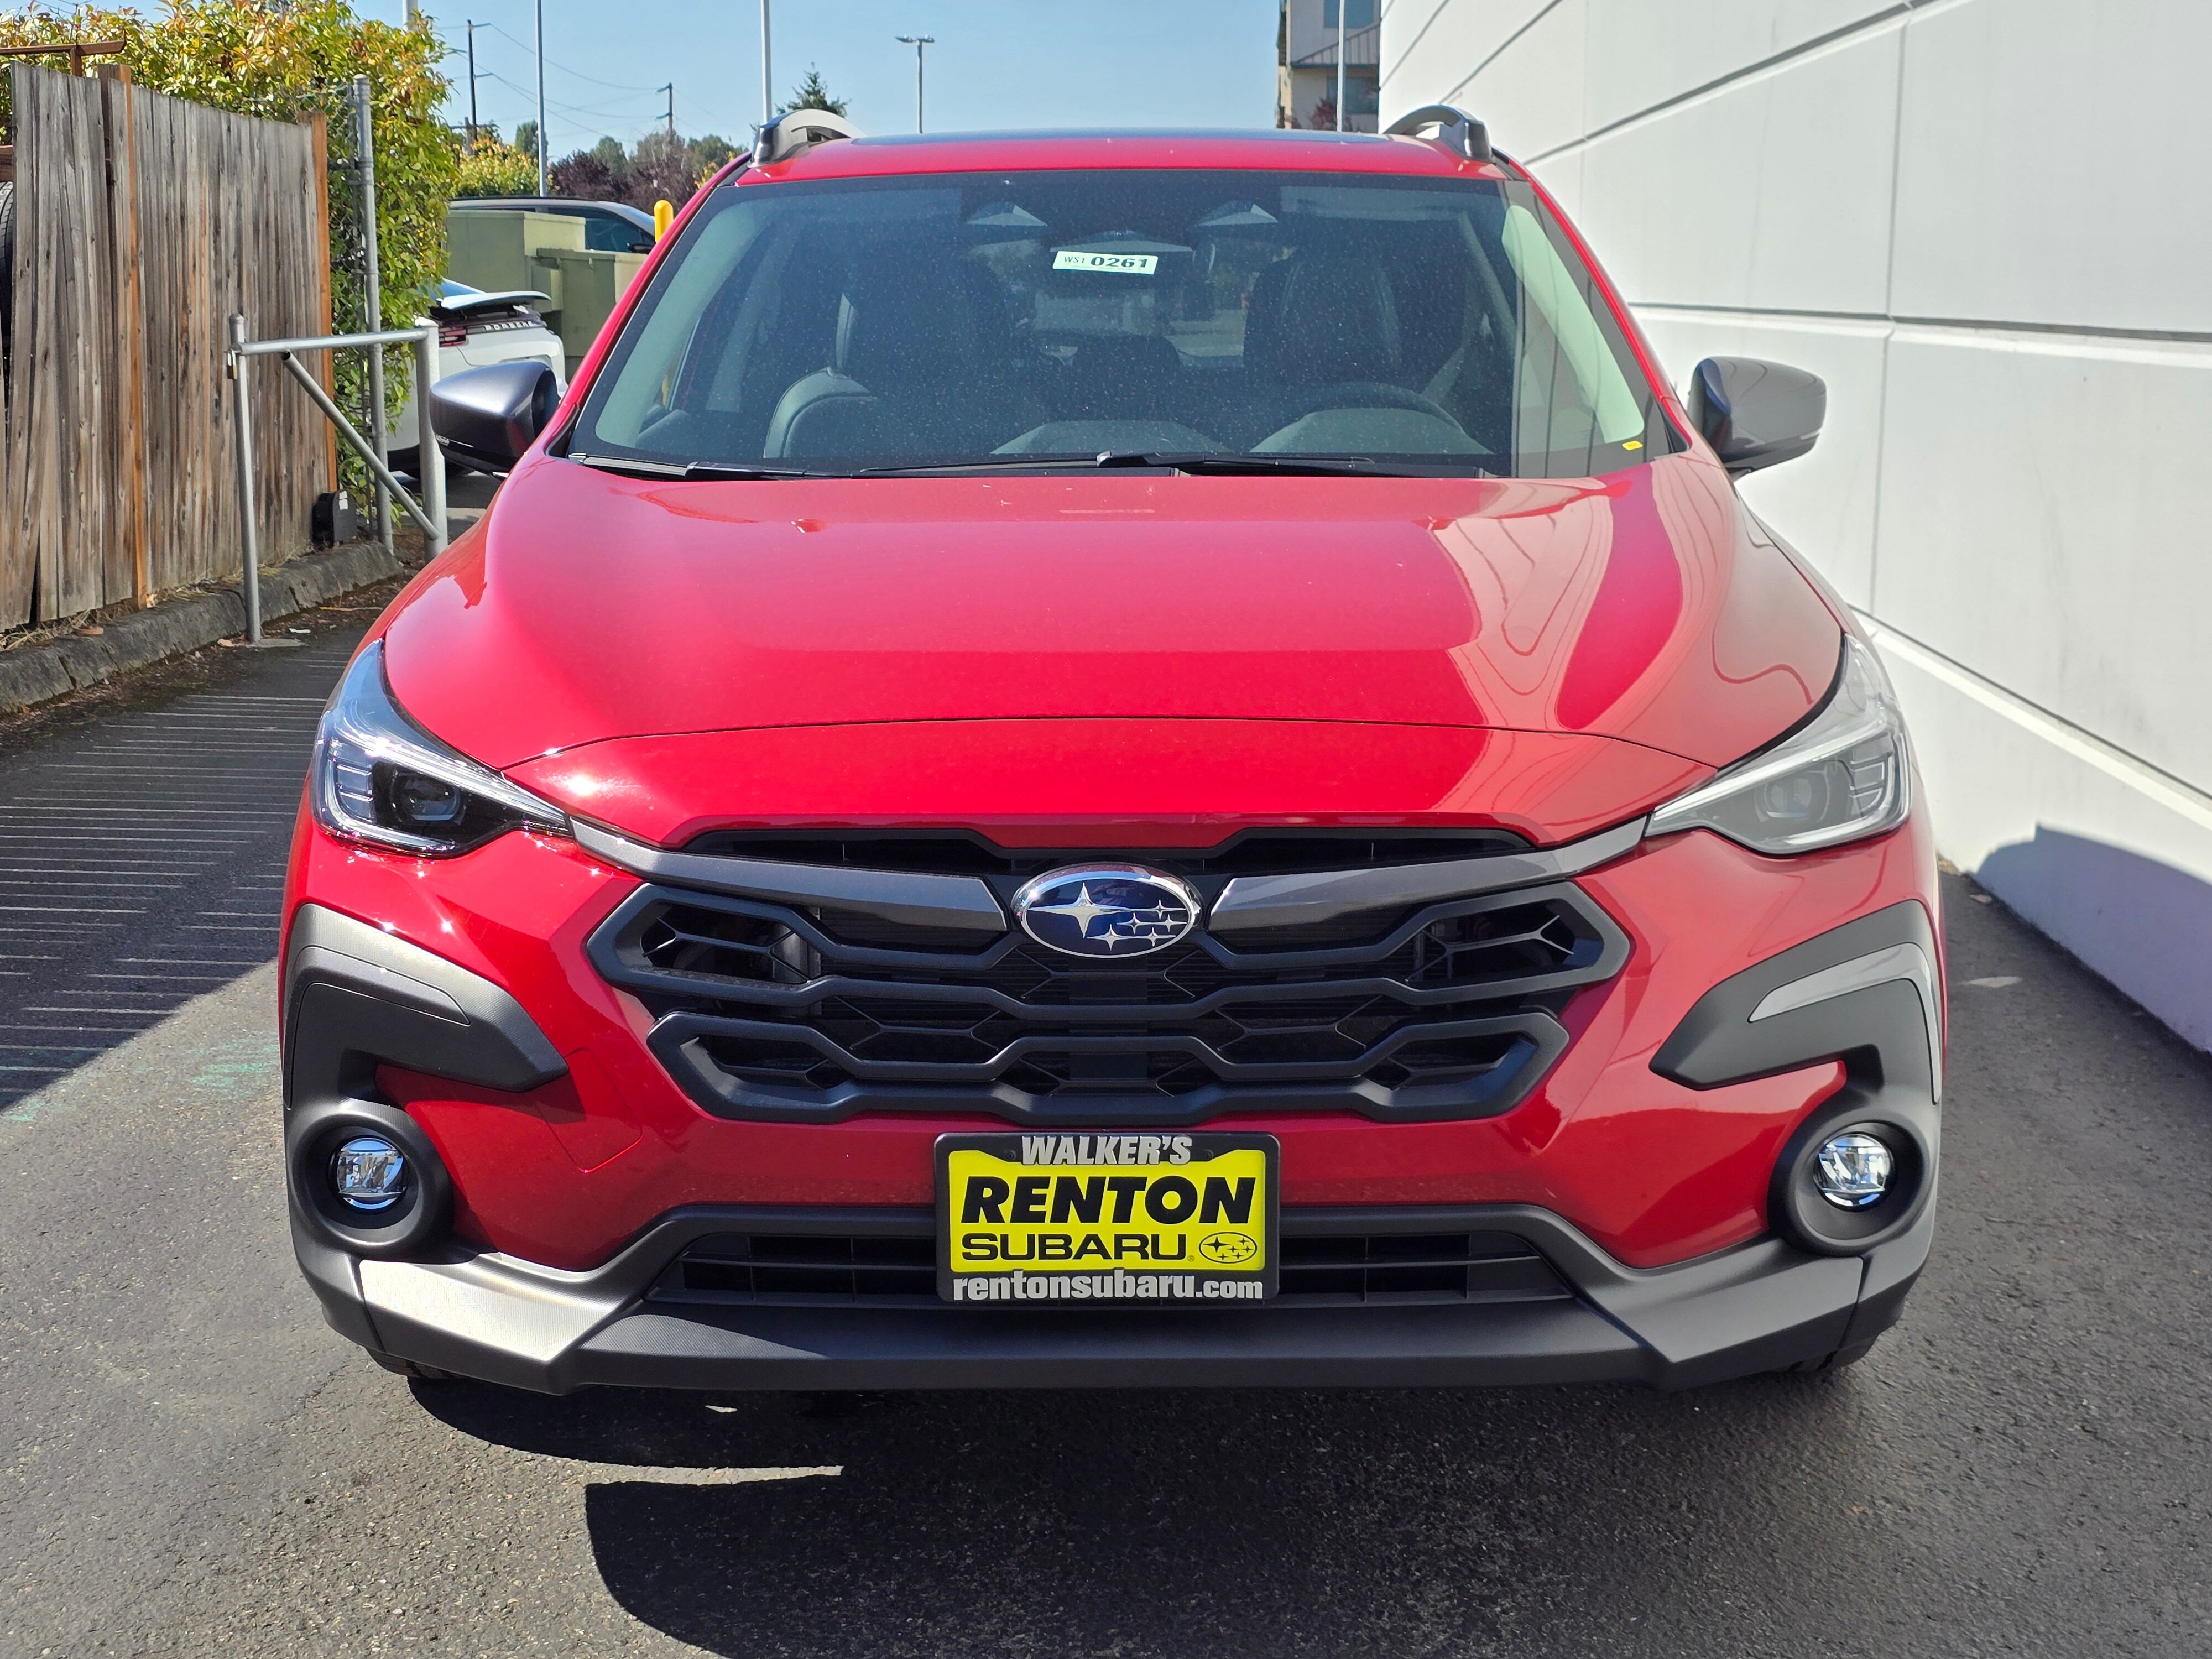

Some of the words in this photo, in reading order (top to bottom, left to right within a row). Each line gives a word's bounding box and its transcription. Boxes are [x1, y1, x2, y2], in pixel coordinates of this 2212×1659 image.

[1091, 257, 1147, 268] 0261
[483, 321, 535, 331] PORSCHE
[1022, 1135, 1192, 1165] WALKER'S
[961, 1175, 1256, 1224] RENTON
[962, 1233, 1186, 1260] SUBARU
[953, 1270, 1263, 1301] rentonsubaru.com
